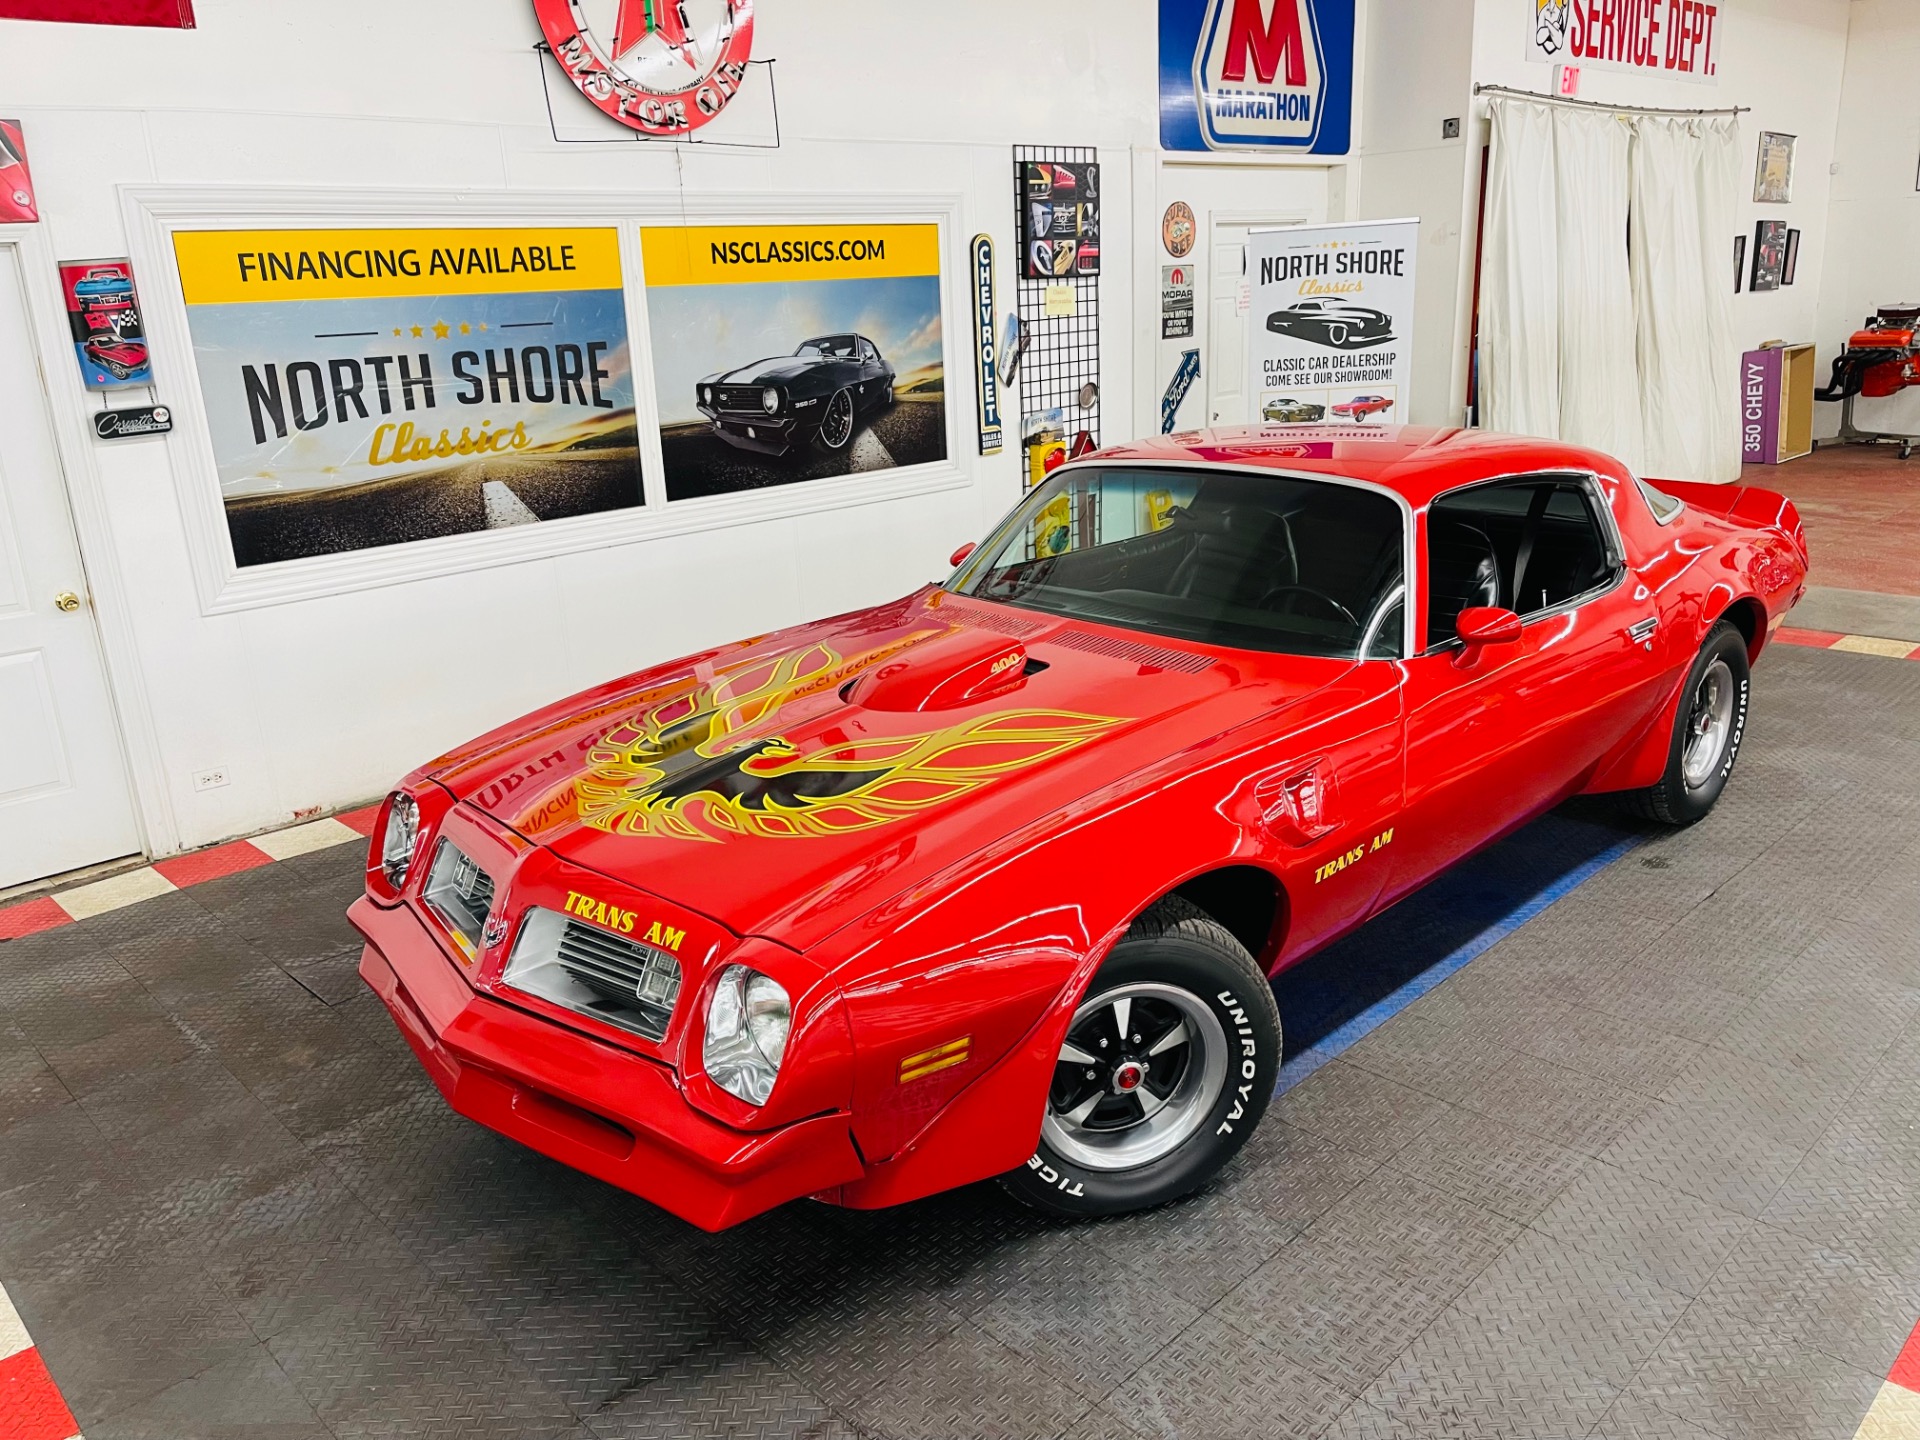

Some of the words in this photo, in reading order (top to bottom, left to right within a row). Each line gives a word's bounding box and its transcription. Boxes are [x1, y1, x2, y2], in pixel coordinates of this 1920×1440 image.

[1570, 0, 1662, 67] SERVICE
[1665, 0, 1717, 76] DEPT.
[557, 34, 690, 130] MOTOR
[1561, 66, 1580, 95] EXIT
[1216, 88, 1310, 122] MARATHON
[711, 239, 886, 265] NSCLASSICS.COM
[1170, 233, 1192, 255] BEE
[237, 248, 421, 282] FINANCING
[429, 245, 577, 275] AVAILABLE
[1261, 253, 1329, 286] NORTH
[1335, 248, 1405, 278] SHORE
[1162, 289, 1193, 300] MOPAR
[1298, 278, 1364, 296] Classics
[978, 244, 996, 422] CHEVROLET
[1263, 357, 1306, 373] CLASSIC
[1308, 354, 1330, 371] CAR
[1332, 352, 1397, 370] DEALERSHIP
[1265, 373, 1292, 387] COME
[1294, 371, 1311, 385] SEE
[1313, 369, 1333, 384] OUR
[1335, 367, 1393, 383] SHOWROOM!
[241, 352, 437, 446] NORTH
[451, 340, 614, 409] SHORE
[1168, 368, 1191, 410] Ford
[1745, 363, 1765, 420] CHEVY
[97, 413, 155, 435] Corvette
[368, 418, 533, 467] Classics
[1744, 424, 1762, 452] 350
[990, 652, 1020, 674] 400
[1719, 679, 1748, 778] UNIROYAL
[1315, 843, 1365, 885] TRANS
[1369, 827, 1394, 854] AM
[564, 890, 638, 933] TRANS
[643, 921, 686, 951] AM
[1216, 990, 1257, 1136] UNIROYAL
